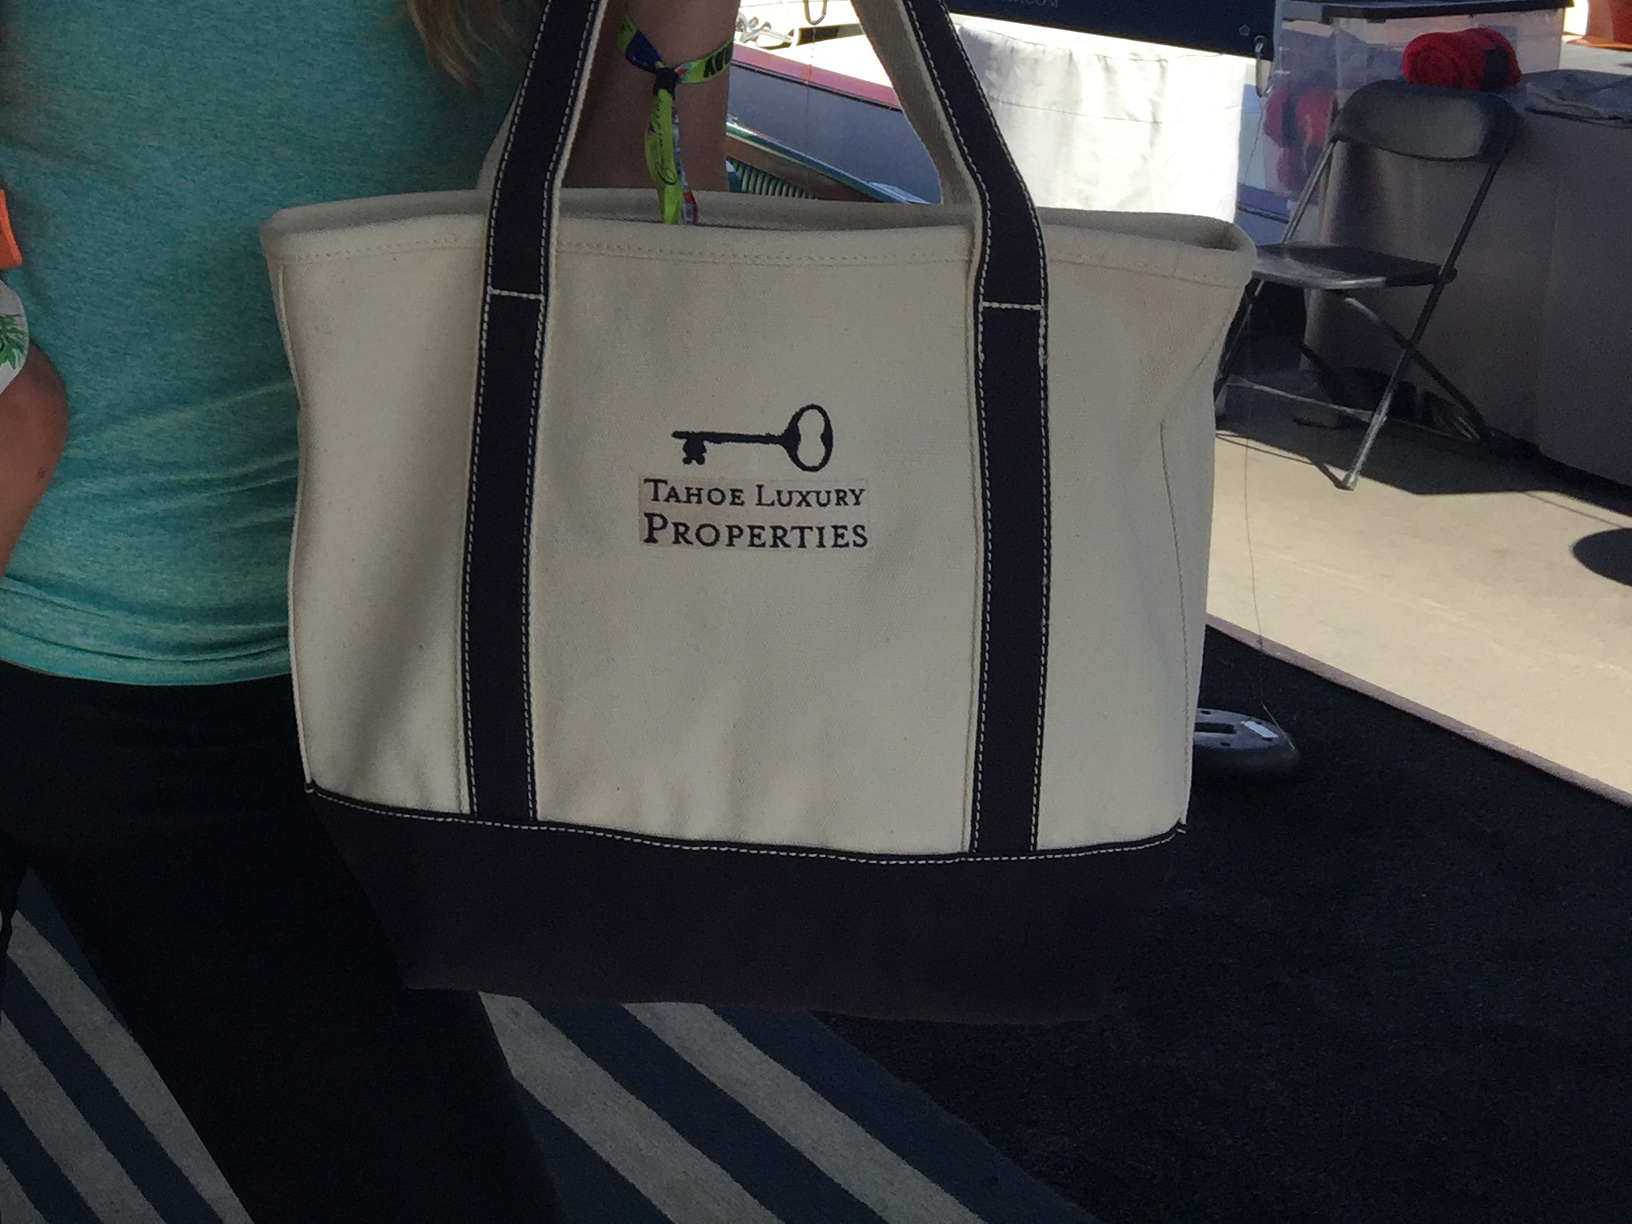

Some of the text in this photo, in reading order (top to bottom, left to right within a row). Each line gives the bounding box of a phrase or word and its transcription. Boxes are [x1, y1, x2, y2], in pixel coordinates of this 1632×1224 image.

[643, 477, 867, 508] TAHOE LUXURY
[643, 512, 869, 550] PROPERTIES
